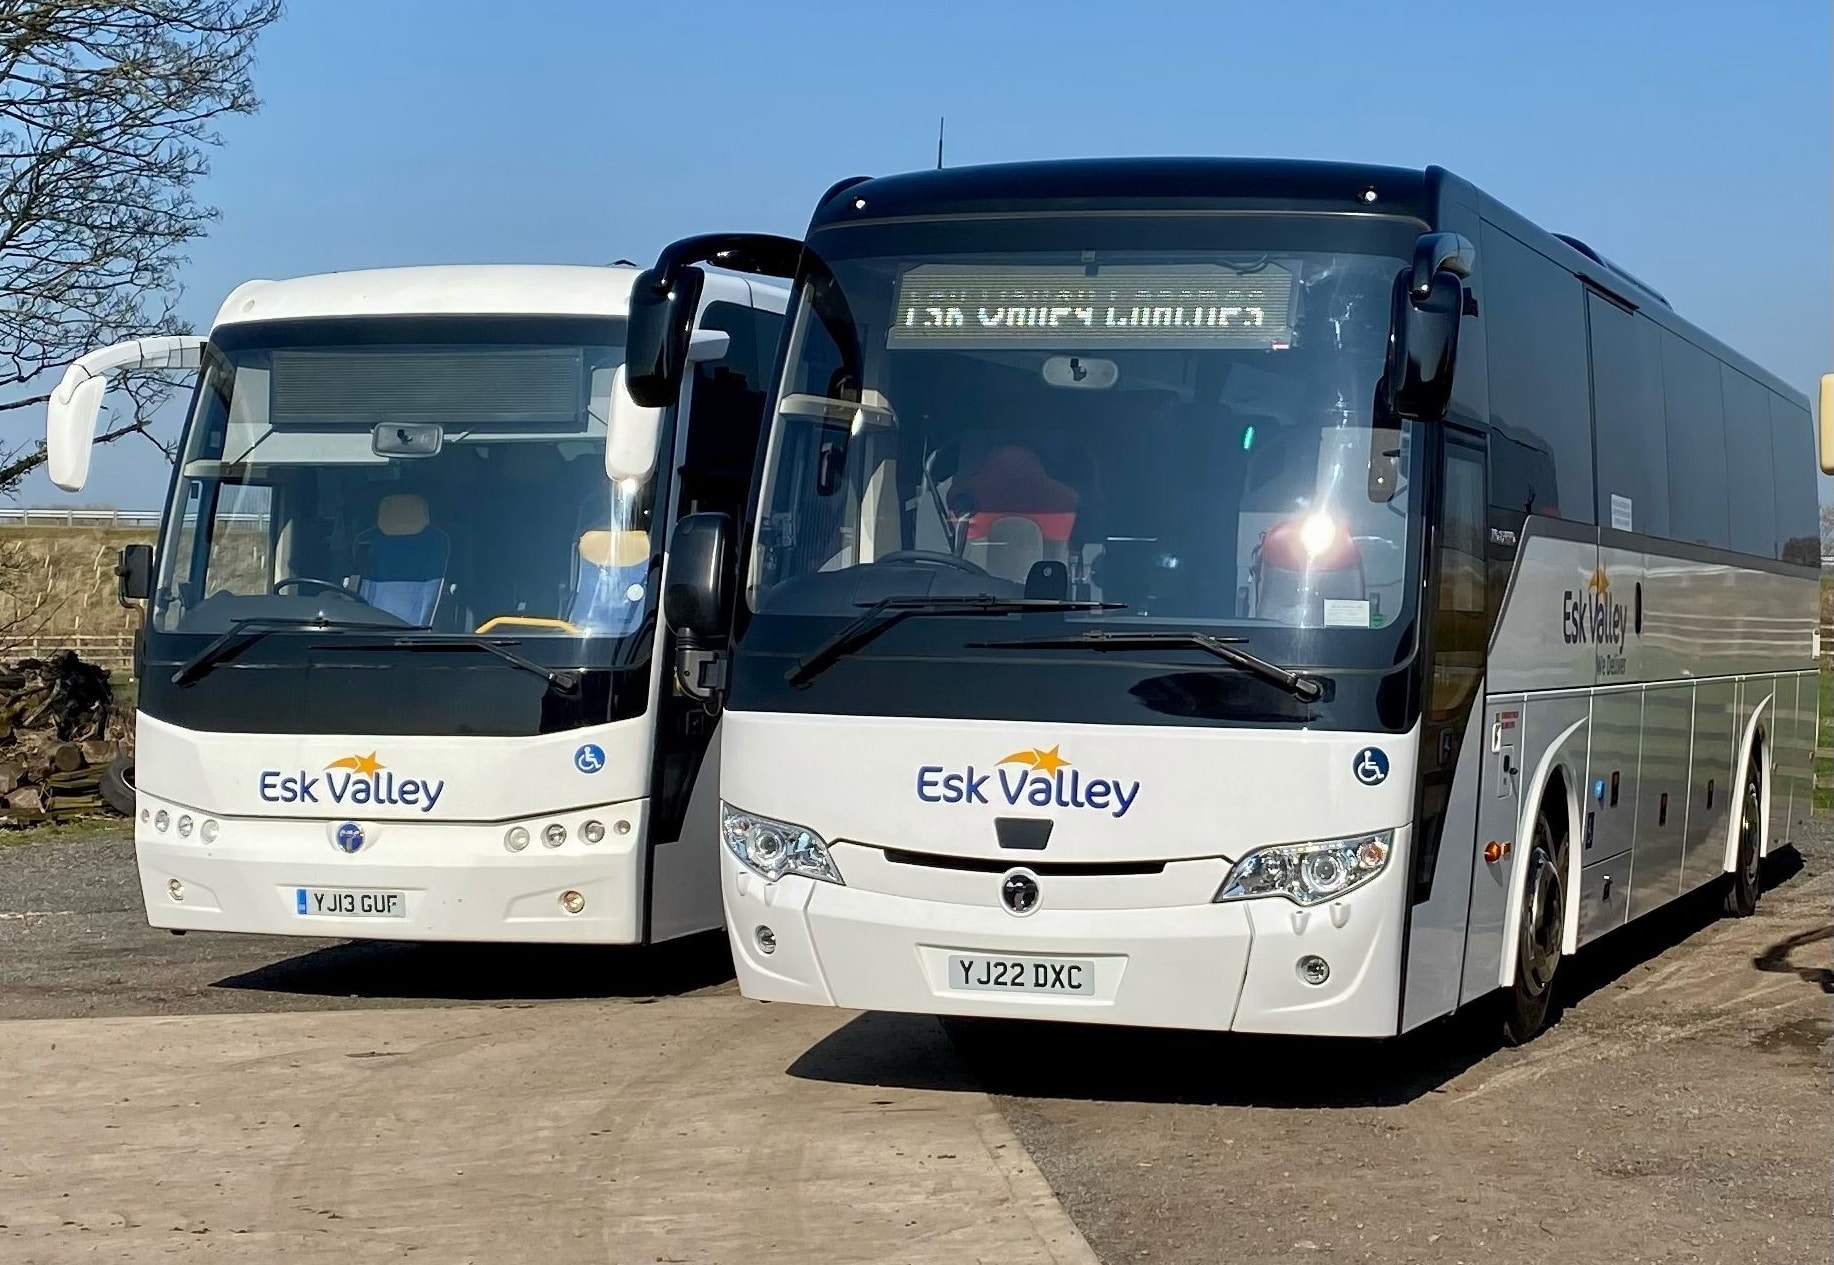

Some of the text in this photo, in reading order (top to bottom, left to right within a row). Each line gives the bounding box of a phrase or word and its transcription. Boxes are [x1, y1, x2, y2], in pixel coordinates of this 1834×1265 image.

[1563, 589, 1628, 654] Esk Valley
[259, 770, 445, 813] Esk Valley
[916, 765, 1141, 819] Esk Valley
[313, 893, 398, 914] YJ13 GUF
[959, 959, 1083, 989] YJ22 DXC
